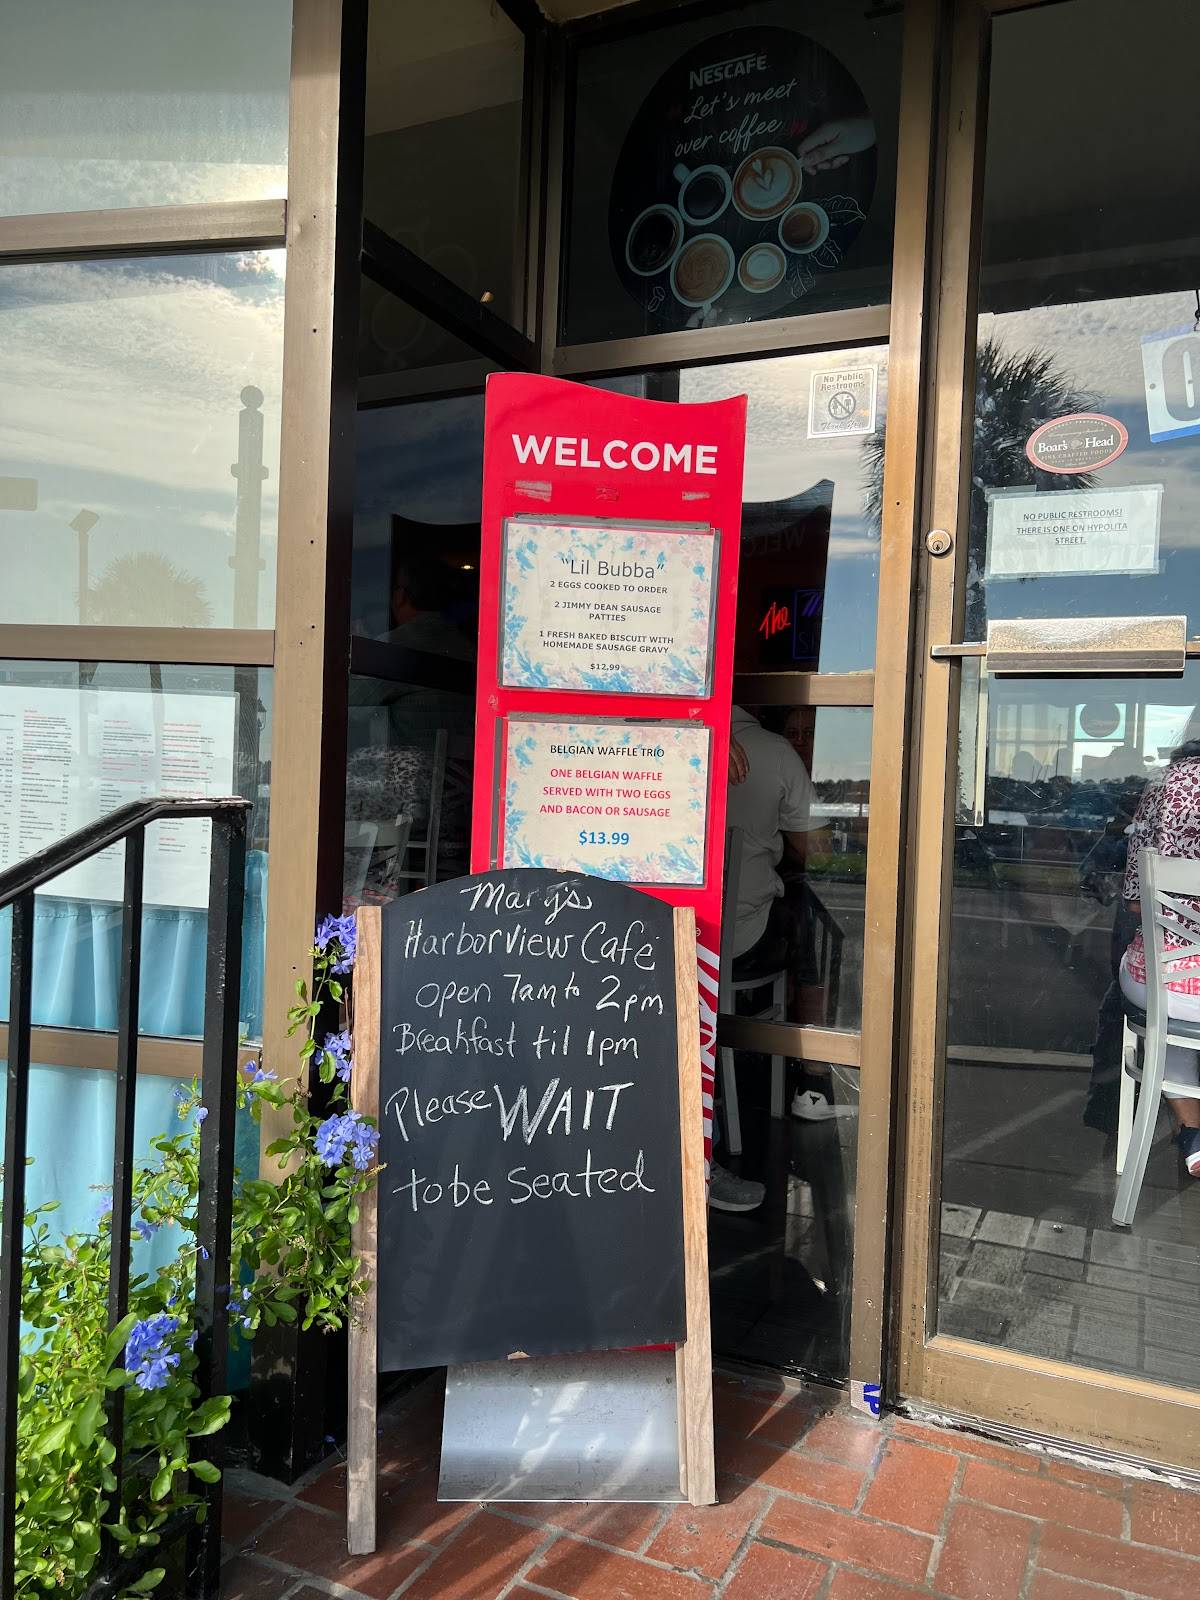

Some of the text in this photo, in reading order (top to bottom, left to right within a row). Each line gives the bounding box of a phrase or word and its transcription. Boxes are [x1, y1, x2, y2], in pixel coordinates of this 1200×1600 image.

[684, 77, 798, 123] Let's meet
[675, 113, 783, 157] over coffee
[824, 371, 864, 383] No Public
[820, 380, 865, 392] Restrooms
[1038, 434, 1114, 453] Boar's Head
[512, 434, 719, 475] WELCOME
[1038, 511, 1067, 520] PUBLIC
[1068, 508, 1123, 518] RESTROOMS!
[1053, 525, 1070, 533] ONE
[1072, 524, 1085, 532] ON
[1087, 523, 1128, 531] HYPOLITA
[550, 580, 555, 588] 2
[558, 581, 581, 589] EGGS
[584, 582, 620, 591] COOKED
[638, 585, 668, 594] ORDER
[562, 602, 591, 610] JIMMY
[594, 603, 618, 611] DEAN
[621, 604, 661, 613] SAUSAGE
[589, 613, 626, 621] PATTIES
[547, 631, 575, 639] FRESH
[578, 632, 607, 641] BAKED
[610, 634, 647, 643] BISCUIT
[649, 636, 674, 644] WITH
[543, 641, 669, 654] HOMEMADE SAUSAGE GRAVY
[590, 663, 620, 671] $12.99
[550, 745, 665, 758] BELGIAN WAFFLE TRIO
[550, 769, 663, 781] ONE BELGIAN WAFFLE
[543, 786, 671, 800] SERVED WITH TWO EGGS
[539, 804, 671, 818] AND BACON OR SAUSAGE
[578, 829, 630, 846] $13.99
[460, 881, 592, 925] Mary's
[503, 973, 556, 1009] 7am
[564, 971, 580, 1000] to
[392, 1016, 639, 1067] Breakfast til 1pm
[385, 1077, 635, 1145] Please WAIT
